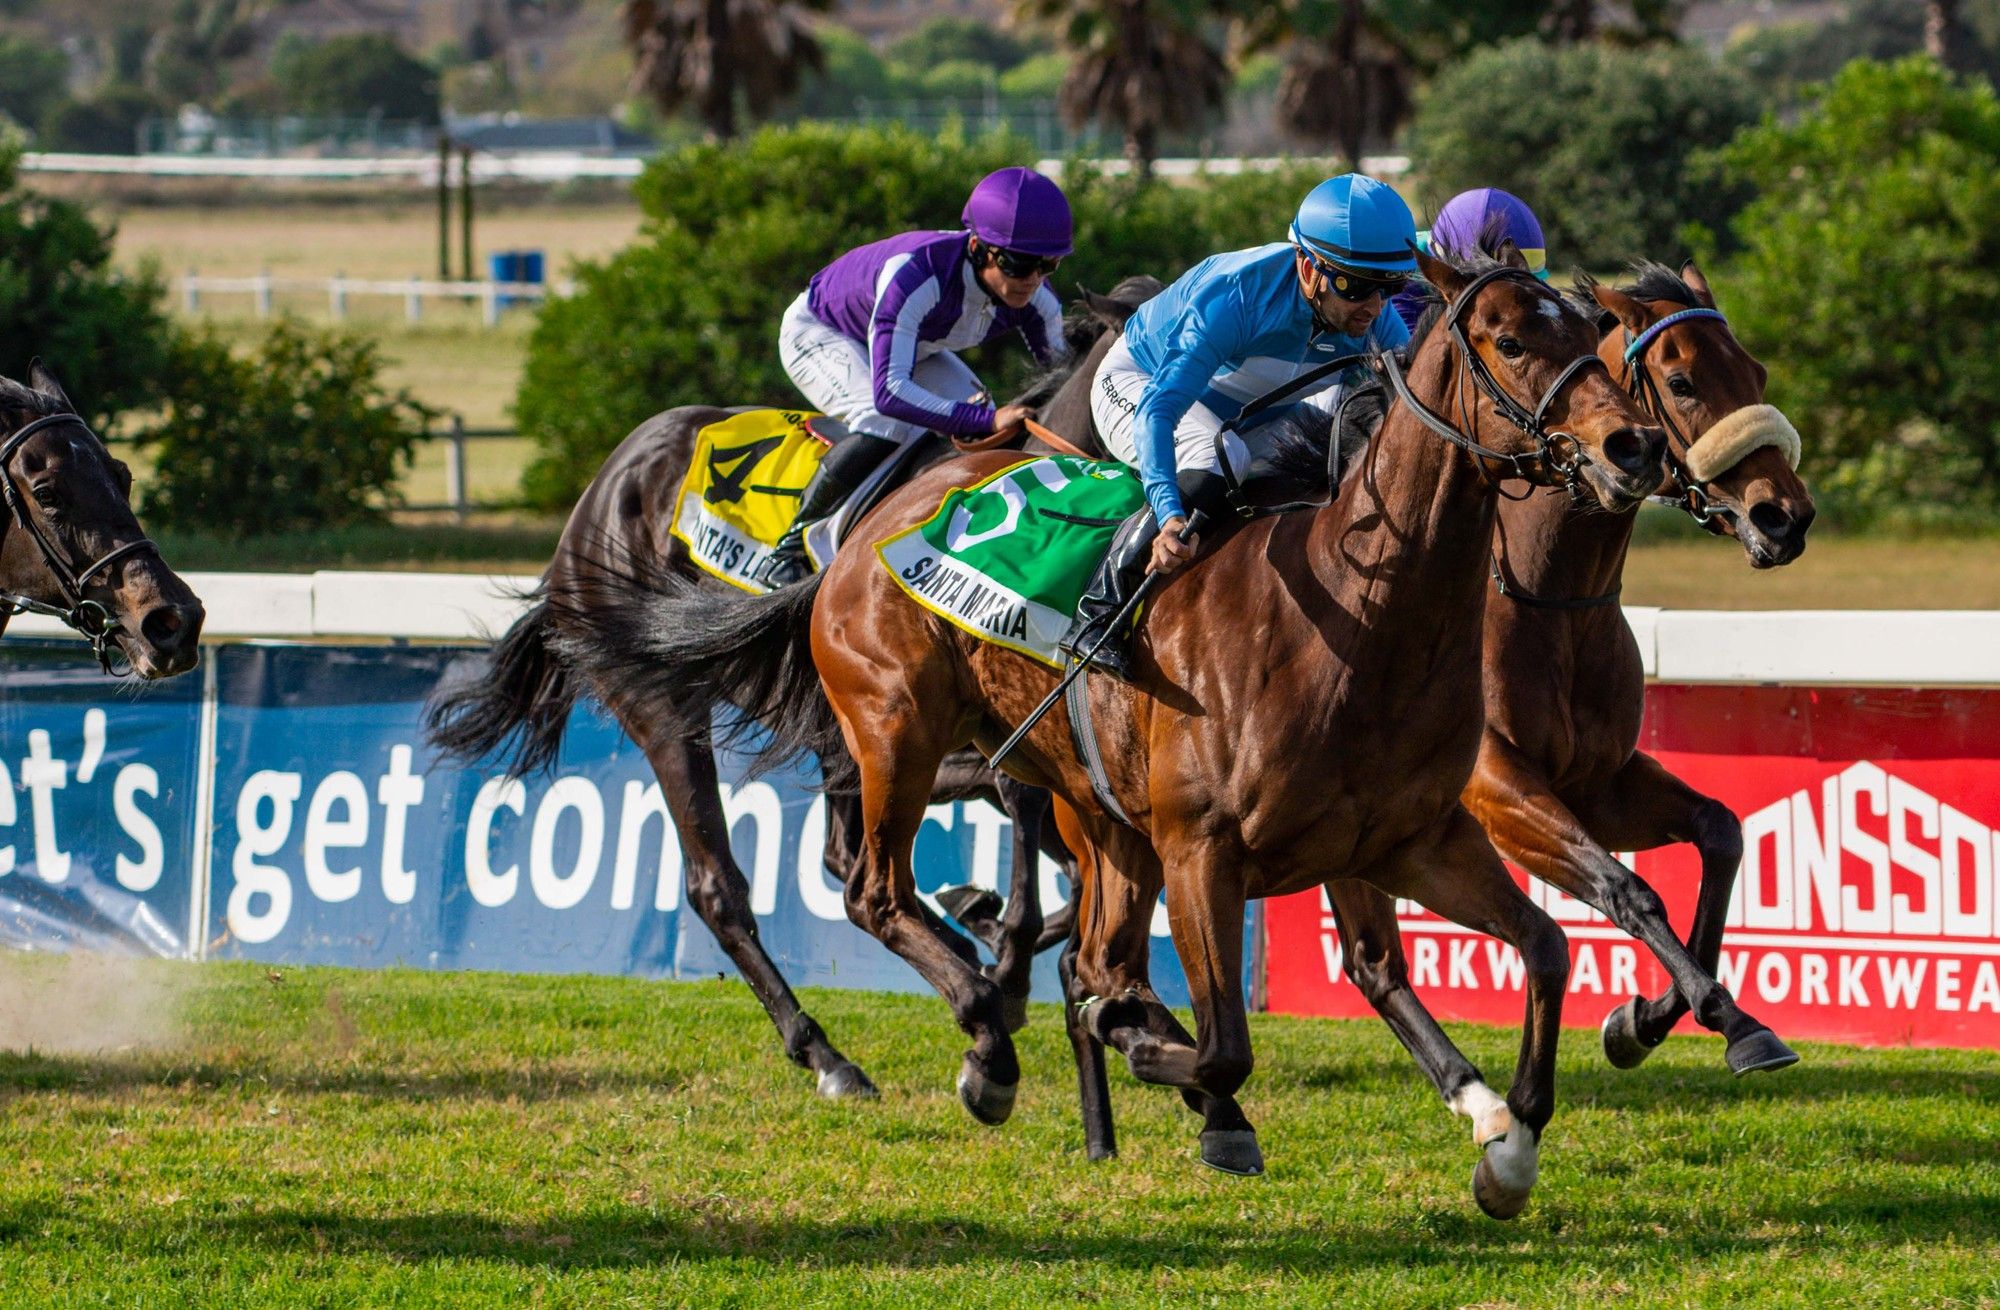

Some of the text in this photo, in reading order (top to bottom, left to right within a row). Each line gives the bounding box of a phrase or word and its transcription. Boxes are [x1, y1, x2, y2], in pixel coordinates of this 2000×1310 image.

[704, 434, 788, 504] 4
[693, 514, 745, 571] NTA'S
[901, 556, 1028, 642] SANTA MARIA
[0, 708, 164, 892] t's
[226, 743, 425, 943] get
[1723, 759, 2000, 938] ONSSO
[1320, 933, 1640, 996] WRKWAR
